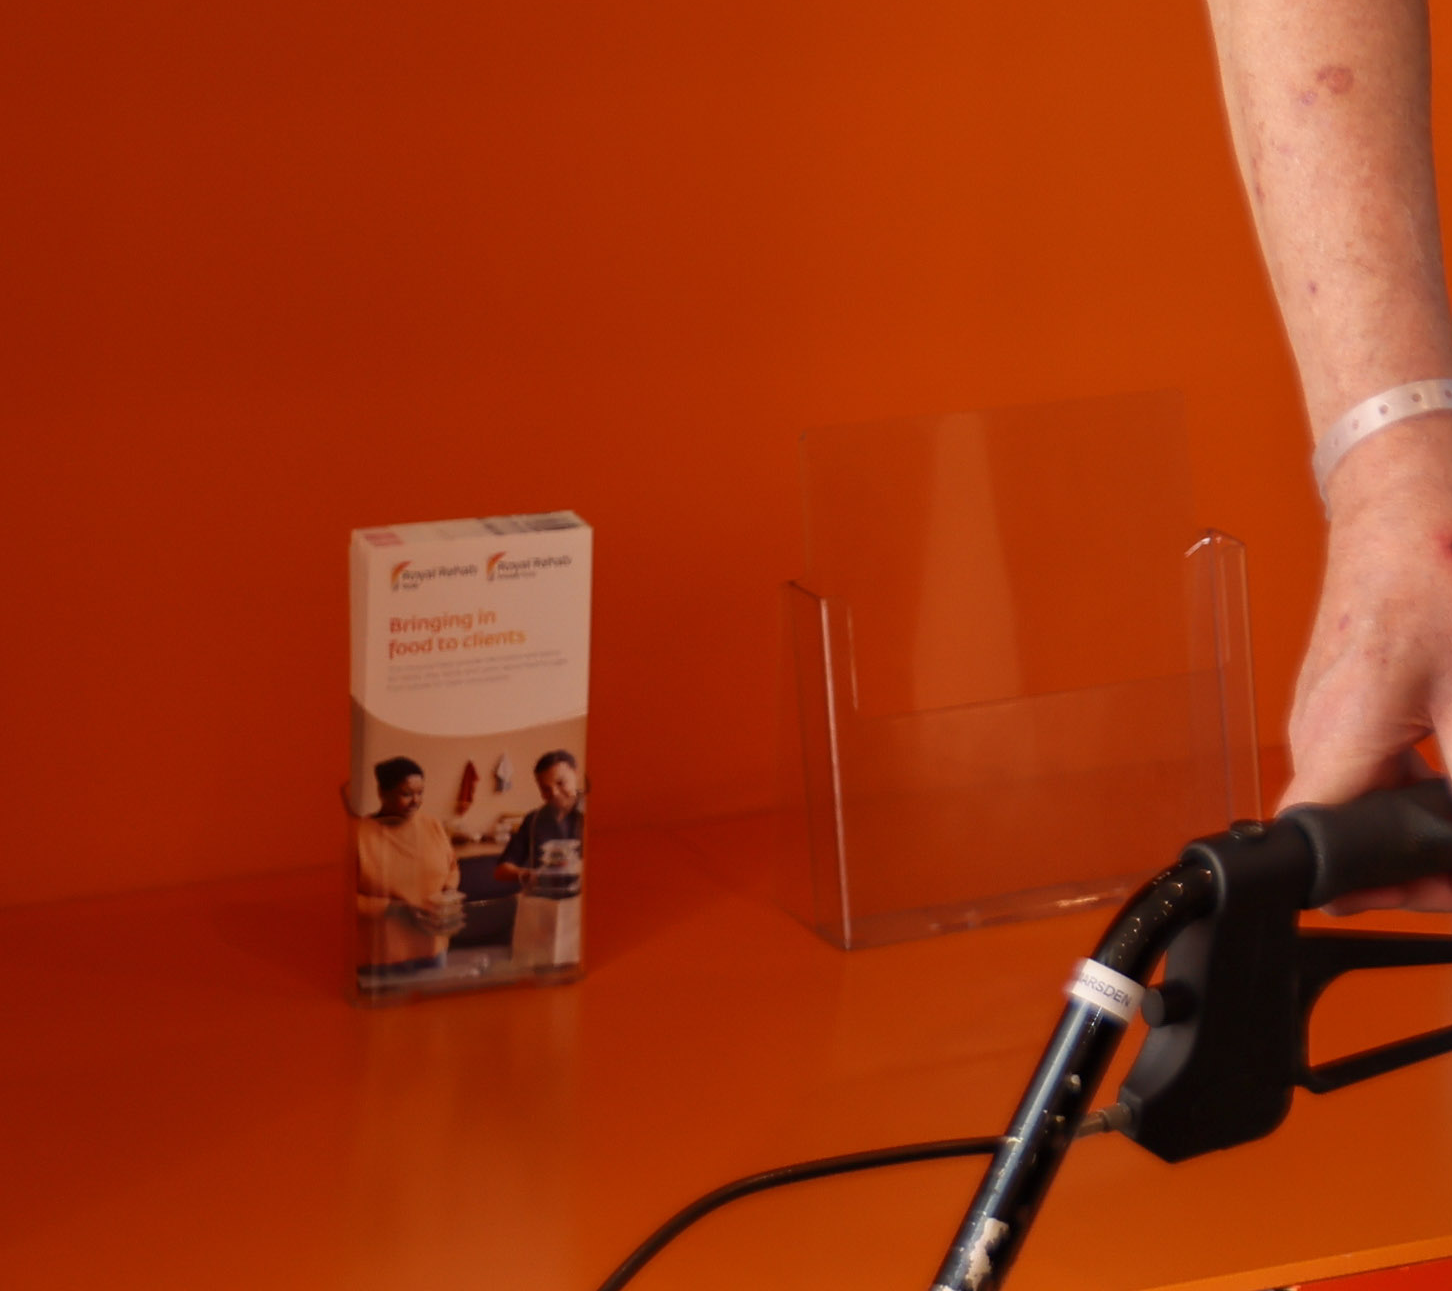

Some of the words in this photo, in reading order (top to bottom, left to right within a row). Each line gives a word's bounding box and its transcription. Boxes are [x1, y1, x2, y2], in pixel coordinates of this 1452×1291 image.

[389, 612, 474, 635] Bringing
[477, 608, 497, 625] in
[388, 637, 434, 660] food
[438, 638, 459, 653] to
[462, 629, 528, 649] clients
[1080, 972, 1132, 1008] ARSDEN
